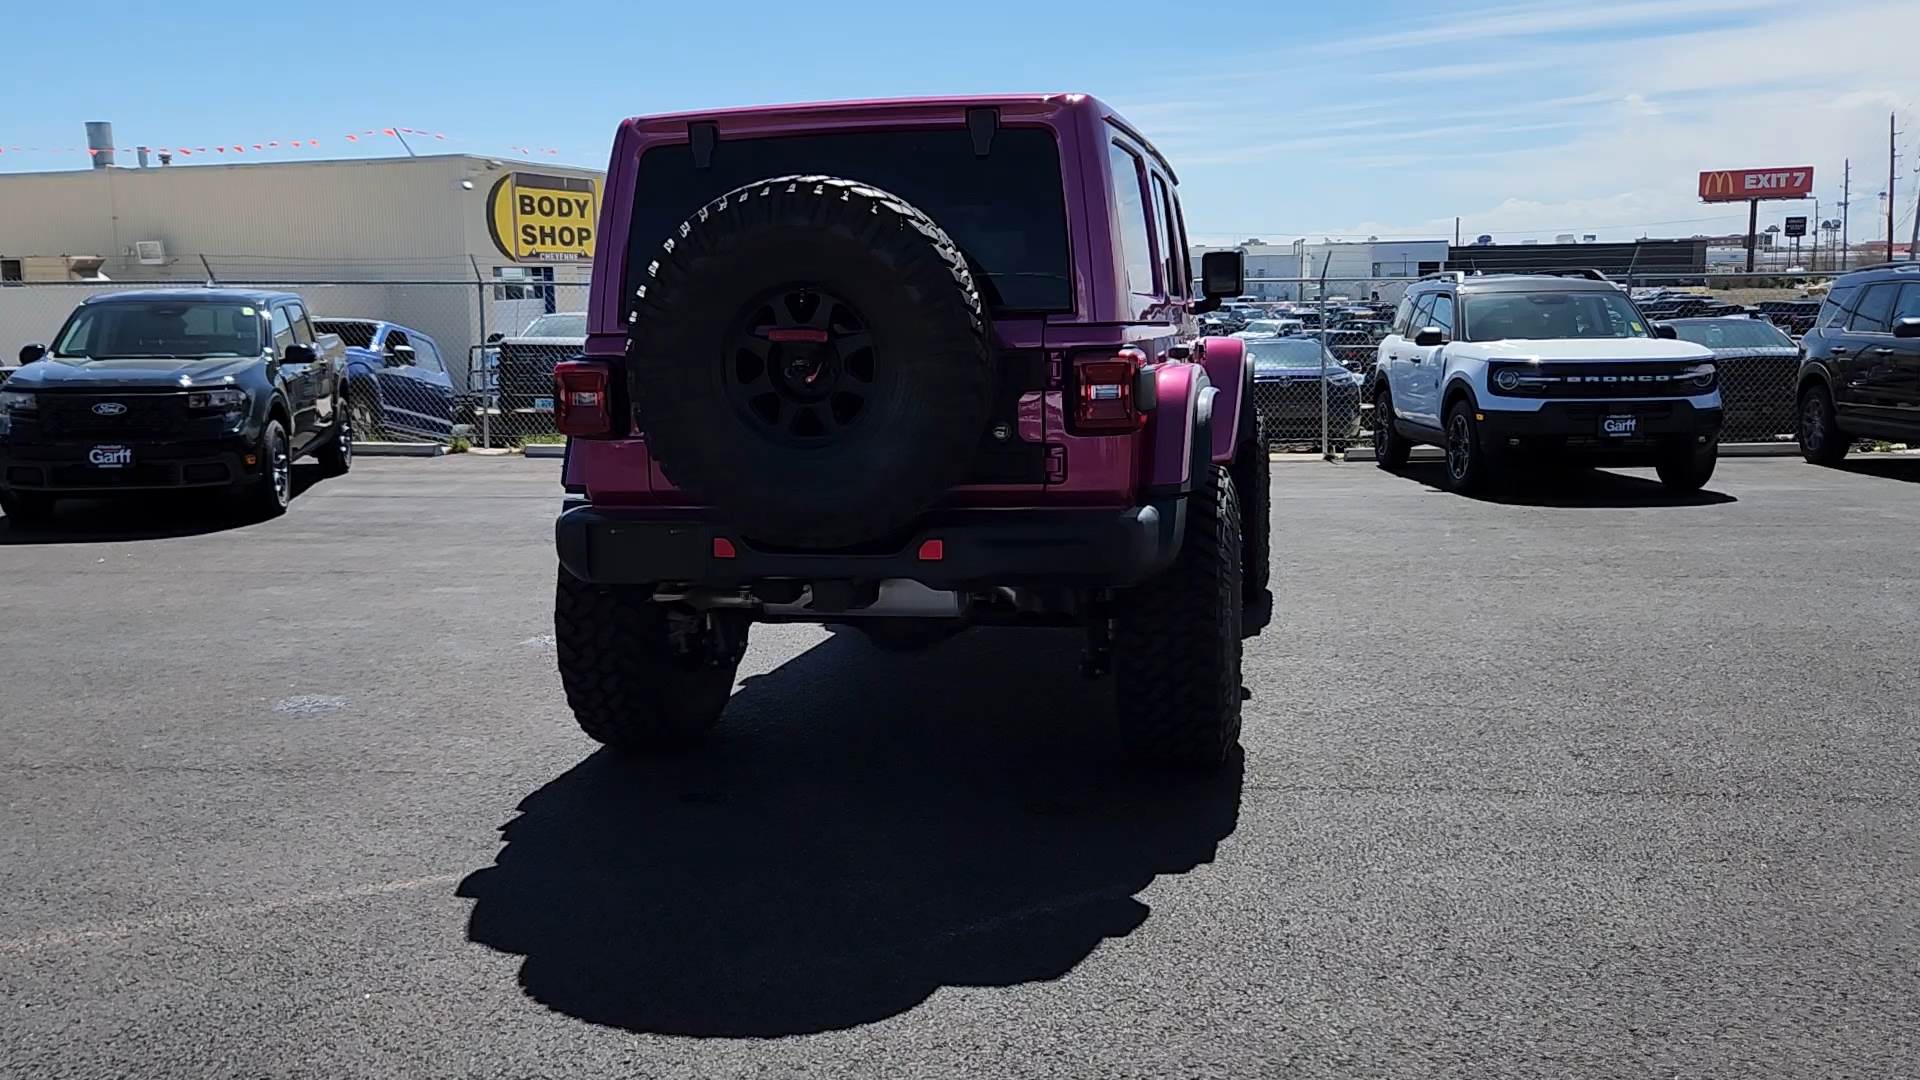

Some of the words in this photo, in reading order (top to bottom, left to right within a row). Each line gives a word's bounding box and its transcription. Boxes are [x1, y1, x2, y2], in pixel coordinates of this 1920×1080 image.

[1744, 172, 1790, 190] EXIT
[1792, 171, 1806, 188] 7
[518, 194, 590, 219] BODY
[521, 224, 592, 247] SHOP
[539, 252, 579, 261] CHEYENNE
[1566, 375, 1670, 383] BRONCO
[1603, 419, 1637, 432] Garff
[89, 449, 132, 464] Garff
